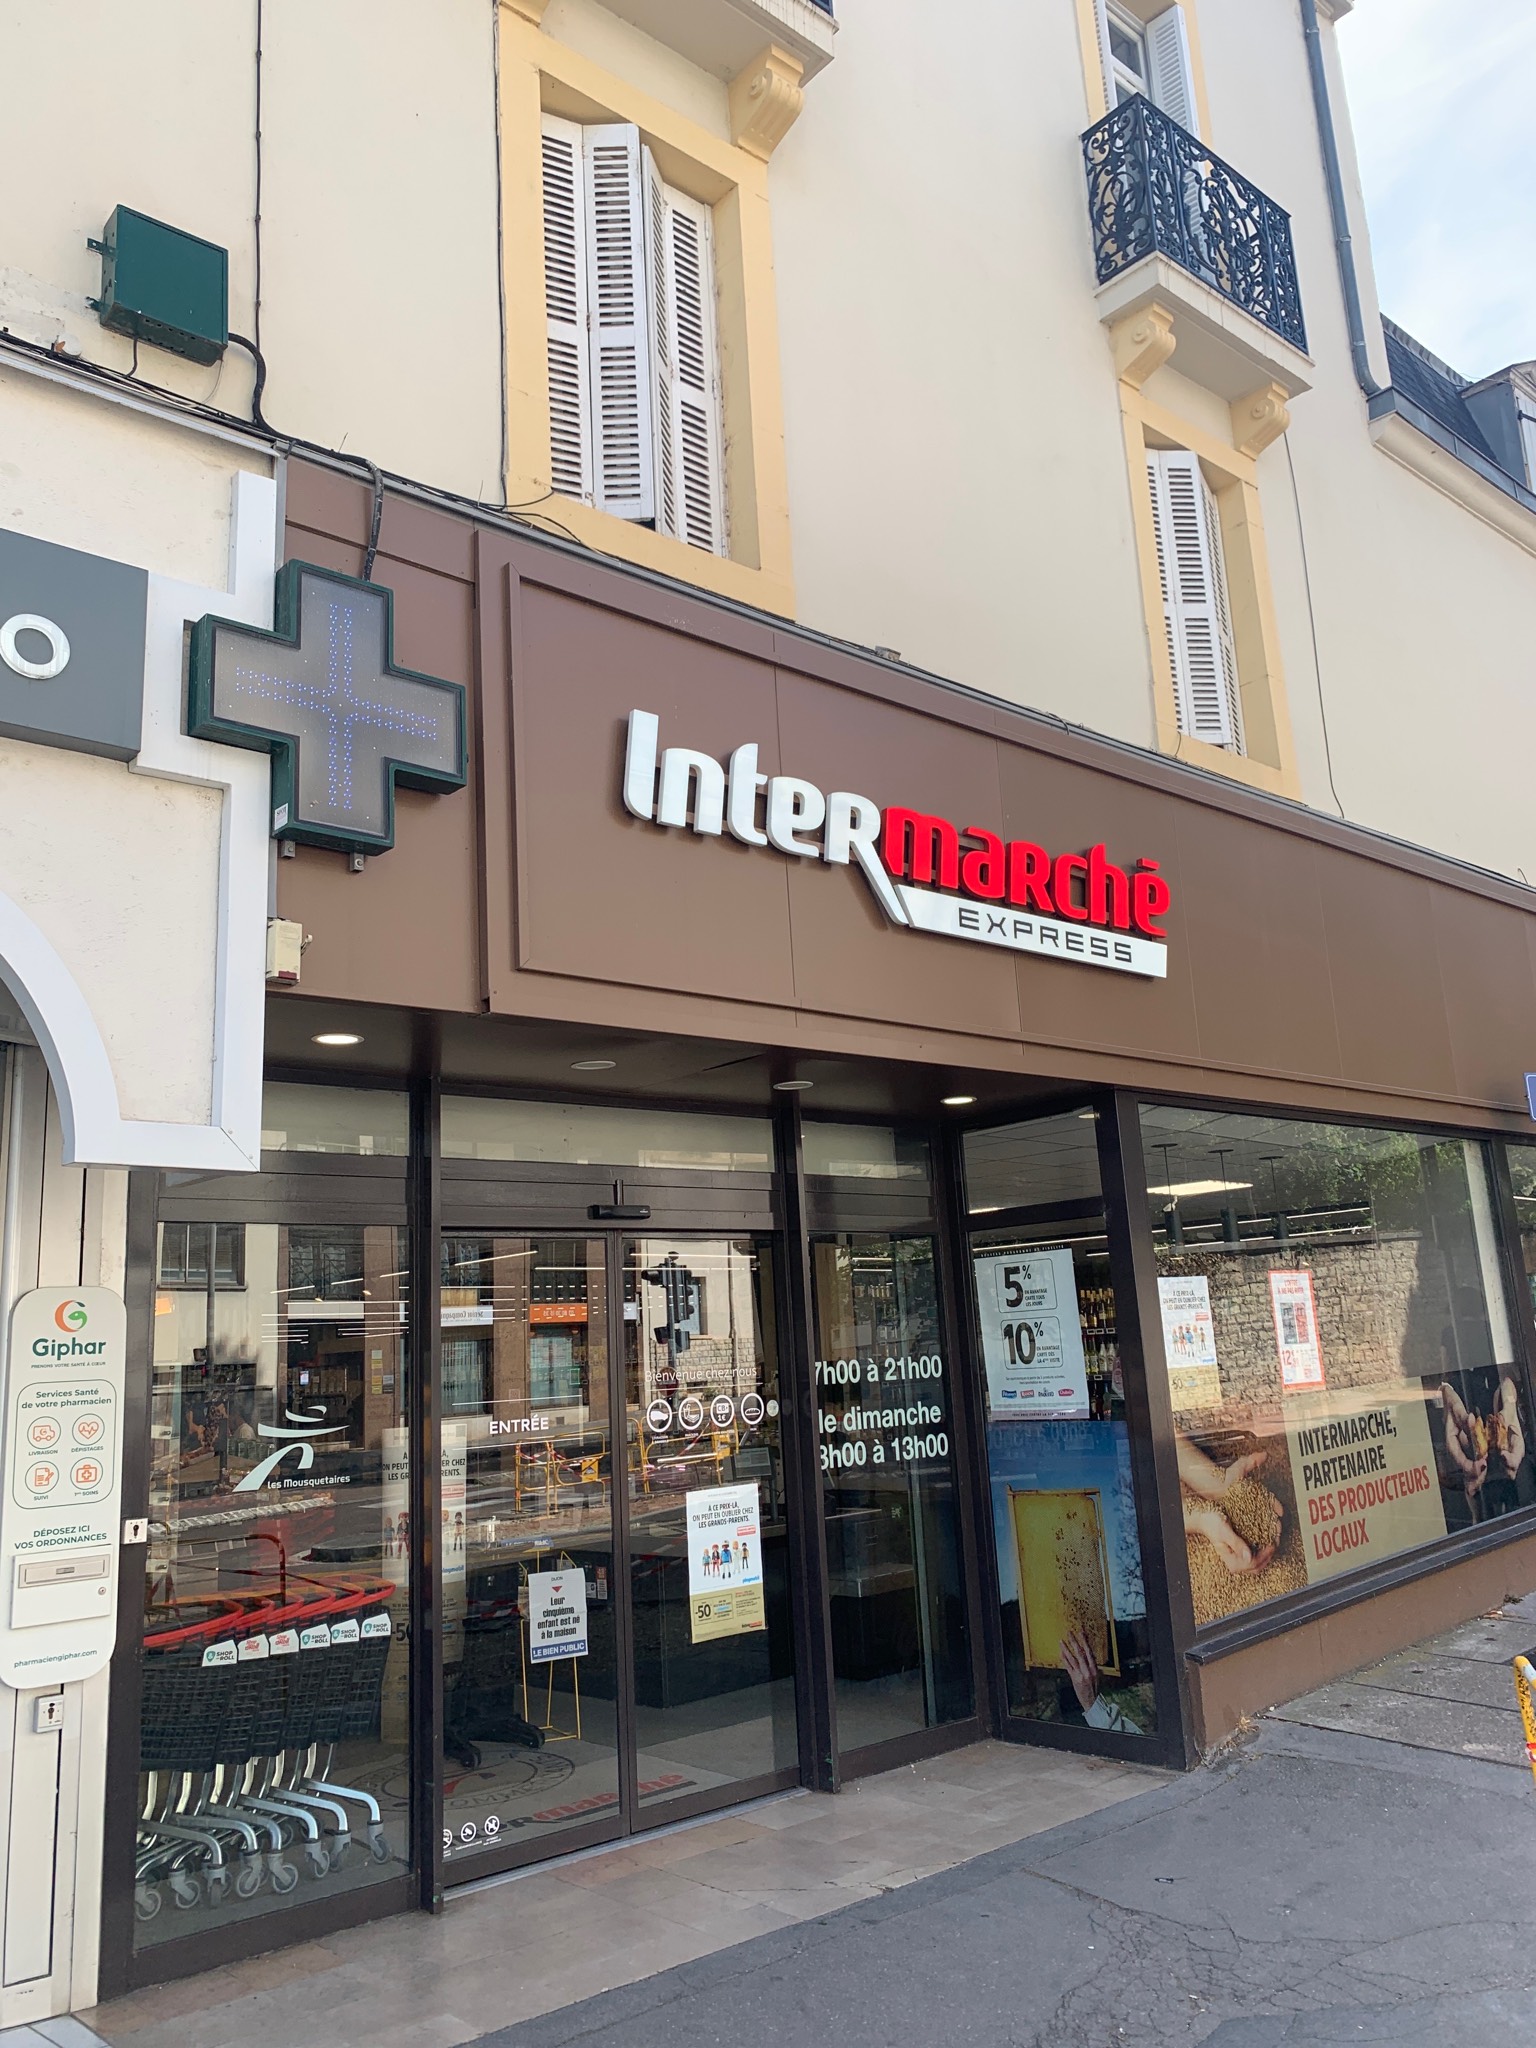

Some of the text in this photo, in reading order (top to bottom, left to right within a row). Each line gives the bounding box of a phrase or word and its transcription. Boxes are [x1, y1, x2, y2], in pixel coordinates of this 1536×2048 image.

[0, 613, 71, 680] O
[958, 907, 1132, 963] EXPRESS
[32, 1337, 107, 1361] Giphar
[644, 1367, 757, 1383] Bienvenue chez nous
[815, 1354, 943, 1386] 7h00 à 21h00
[36, 1388, 99, 1399] Services Santé
[21, 1401, 33, 1409] de
[60, 1397, 112, 1408] pharmacien
[489, 1414, 549, 1435] ENTRÉE
[818, 1401, 942, 1434] le dimanche
[1297, 1407, 1397, 1457] INTERMARCHÉ,
[70, 1445, 104, 1453] DÉPISTAGES
[873, 1439, 885, 1464] à
[891, 1433, 949, 1462] 13h00
[1302, 1444, 1387, 1491] PARTENAIRE
[283, 1475, 351, 1488] Mousquetaires
[388, 1472, 399, 1481] LES
[1308, 1465, 1430, 1526] DES PRODUCTEURS
[692, 1506, 754, 1522] ON PEUT EN OUBLIER CHEZ
[33, 1525, 90, 1538] DÉPOSEZ ICI
[698, 1521, 707, 1529] LES
[14, 1533, 107, 1550] VOS ORDONNANCES
[1313, 1518, 1370, 1560] LOCAUX
[550, 1596, 565, 1606] Leur
[542, 1606, 575, 1618] cinquième
[695, 1603, 711, 1619] -50
[537, 1615, 581, 1630] enfant est né
[541, 1627, 577, 1639] à la maison
[533, 1642, 585, 1657] LE BIEN PUBLIC
[13, 1649, 98, 1668] pharmaciengiphar.com
